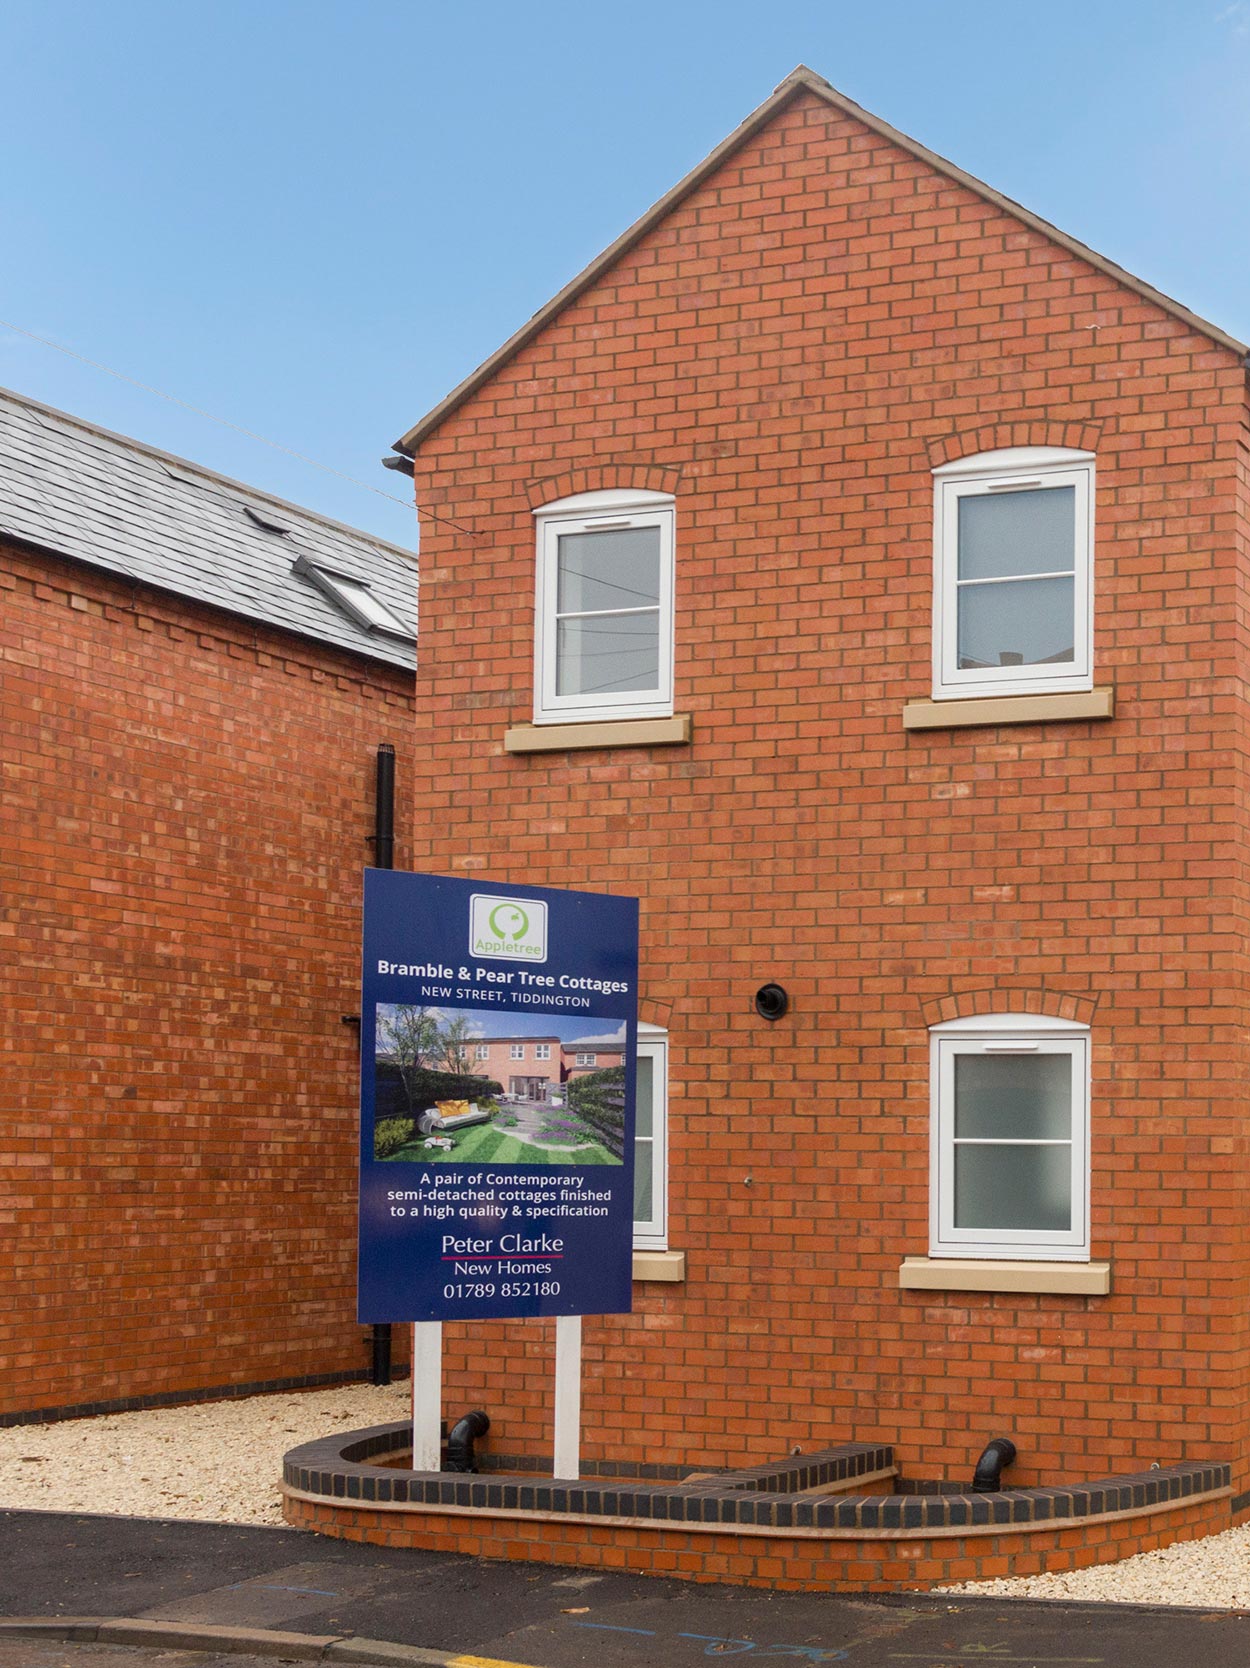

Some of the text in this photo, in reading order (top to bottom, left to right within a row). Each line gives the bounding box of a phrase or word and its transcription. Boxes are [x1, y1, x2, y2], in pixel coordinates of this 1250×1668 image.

[475, 939, 541, 955] Appletree
[377, 959, 629, 995] Bramble & Pear Tree Cottages
[421, 986, 590, 1008] NEW STREET, TIDDINGTON
[420, 1172, 584, 1189] A pair of Contemporary
[387, 1188, 612, 1204] semi-detached cottages finished
[390, 1204, 609, 1220] to a high quality & specification
[442, 1233, 564, 1254] Peter Clarke
[454, 1260, 552, 1276] New Homes
[443, 1281, 561, 1299] 01789 852180
